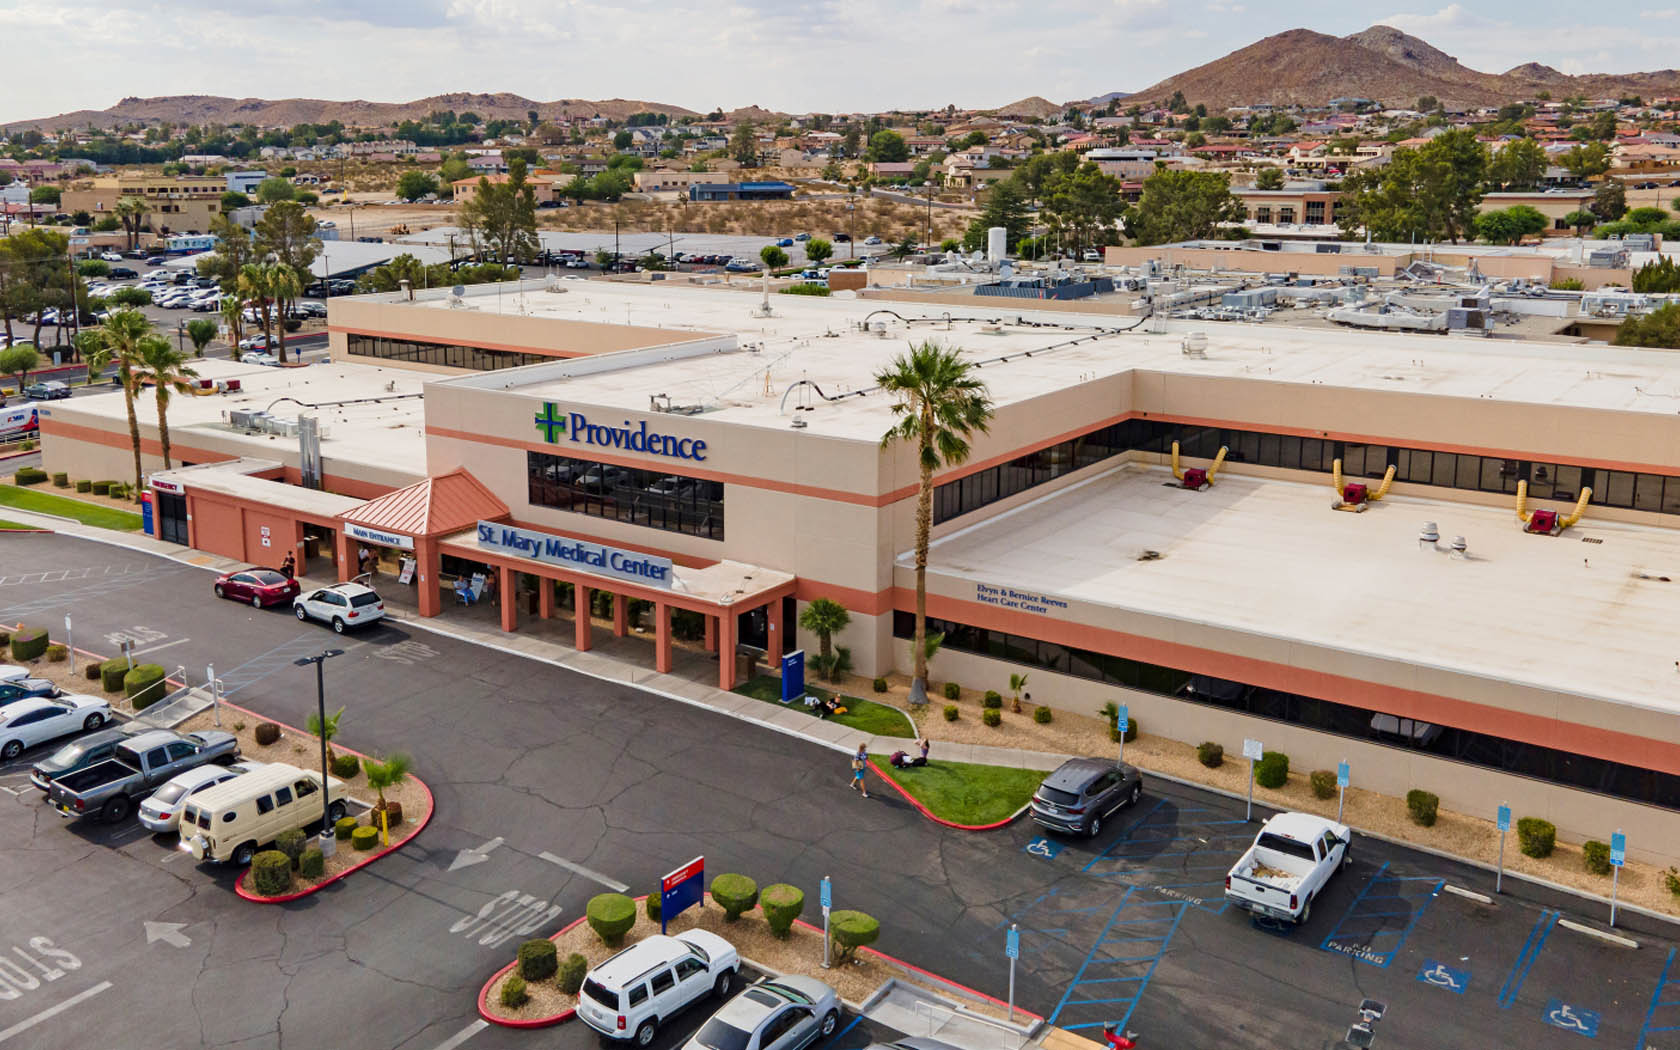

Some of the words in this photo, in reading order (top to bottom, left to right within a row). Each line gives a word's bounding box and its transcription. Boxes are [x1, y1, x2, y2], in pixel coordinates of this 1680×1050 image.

[569, 412, 708, 462] Providence
[353, 527, 369, 538] MAIN
[369, 531, 401, 545] ENTRANCE
[478, 524, 497, 544] St.
[502, 529, 542, 558] Mary
[545, 538, 607, 568] Medical
[610, 551, 670, 580] Center
[977, 584, 998, 595] Elvyn
[1000, 588, 1007, 596] &
[1009, 590, 1038, 602] Bernice
[1041, 596, 1068, 608] Reeves
[977, 593, 999, 604] Heart
[1000, 597, 1019, 608] Care
[1020, 601, 1047, 613] Center
[1327, 941, 1385, 964] PARKING
